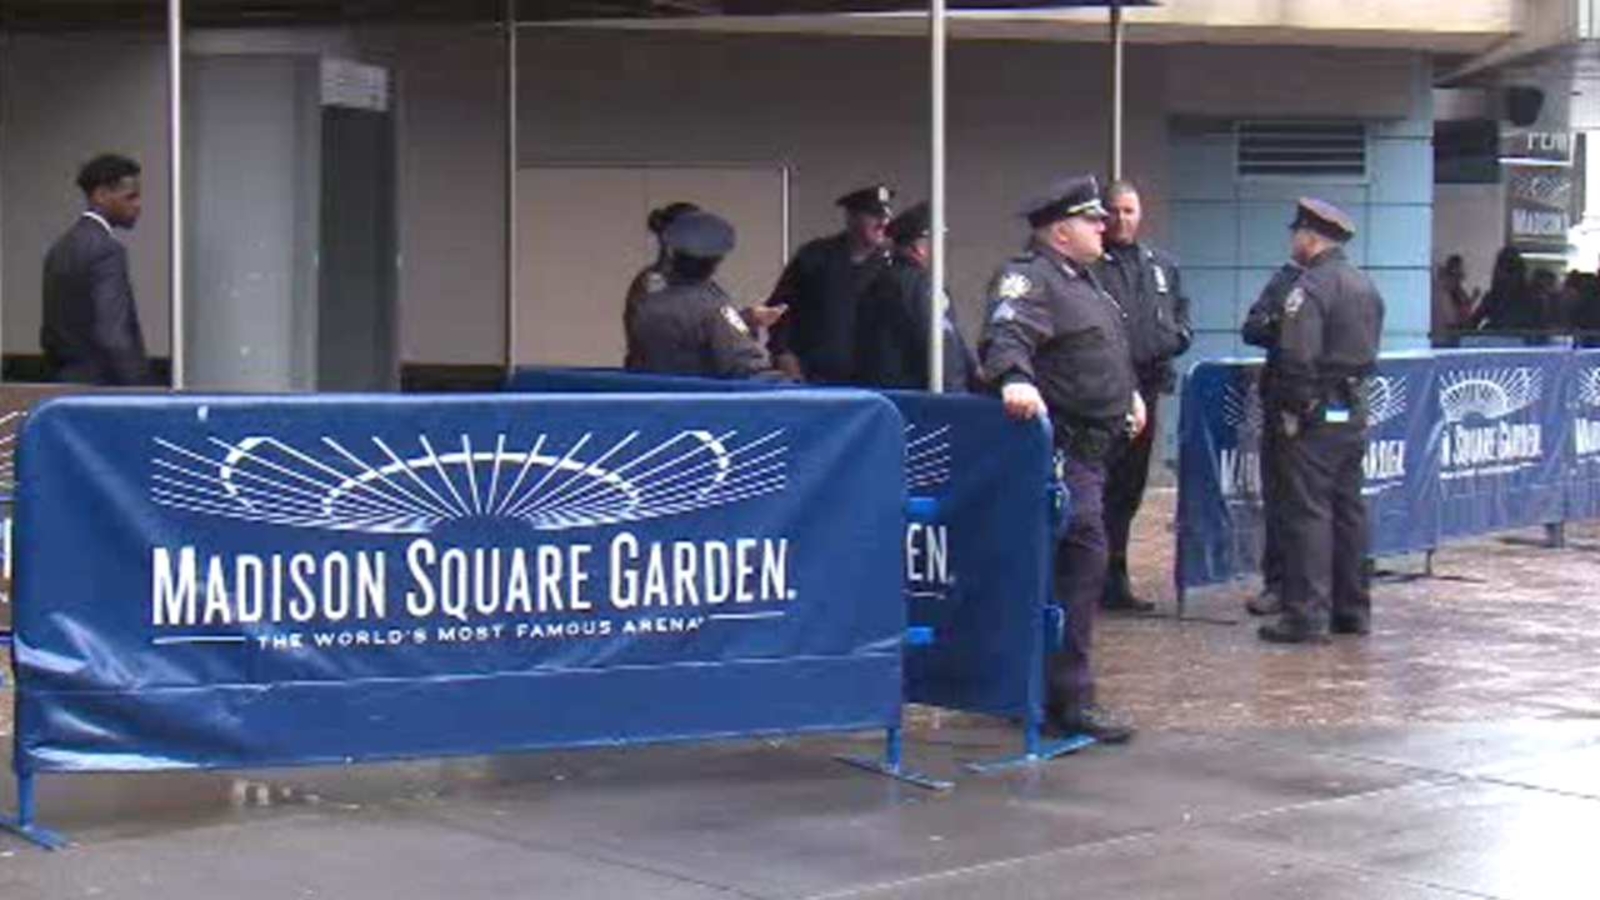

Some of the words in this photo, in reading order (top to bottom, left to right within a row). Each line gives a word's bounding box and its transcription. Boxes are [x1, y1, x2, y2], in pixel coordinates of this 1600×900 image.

[152, 546, 386, 626] MADISON
[405, 538, 592, 620] SQUARE
[258, 632, 303, 649] THE
[314, 627, 427, 647] WORLD'S
[438, 625, 504, 642] MOST
[516, 620, 612, 638] FAMOUS
